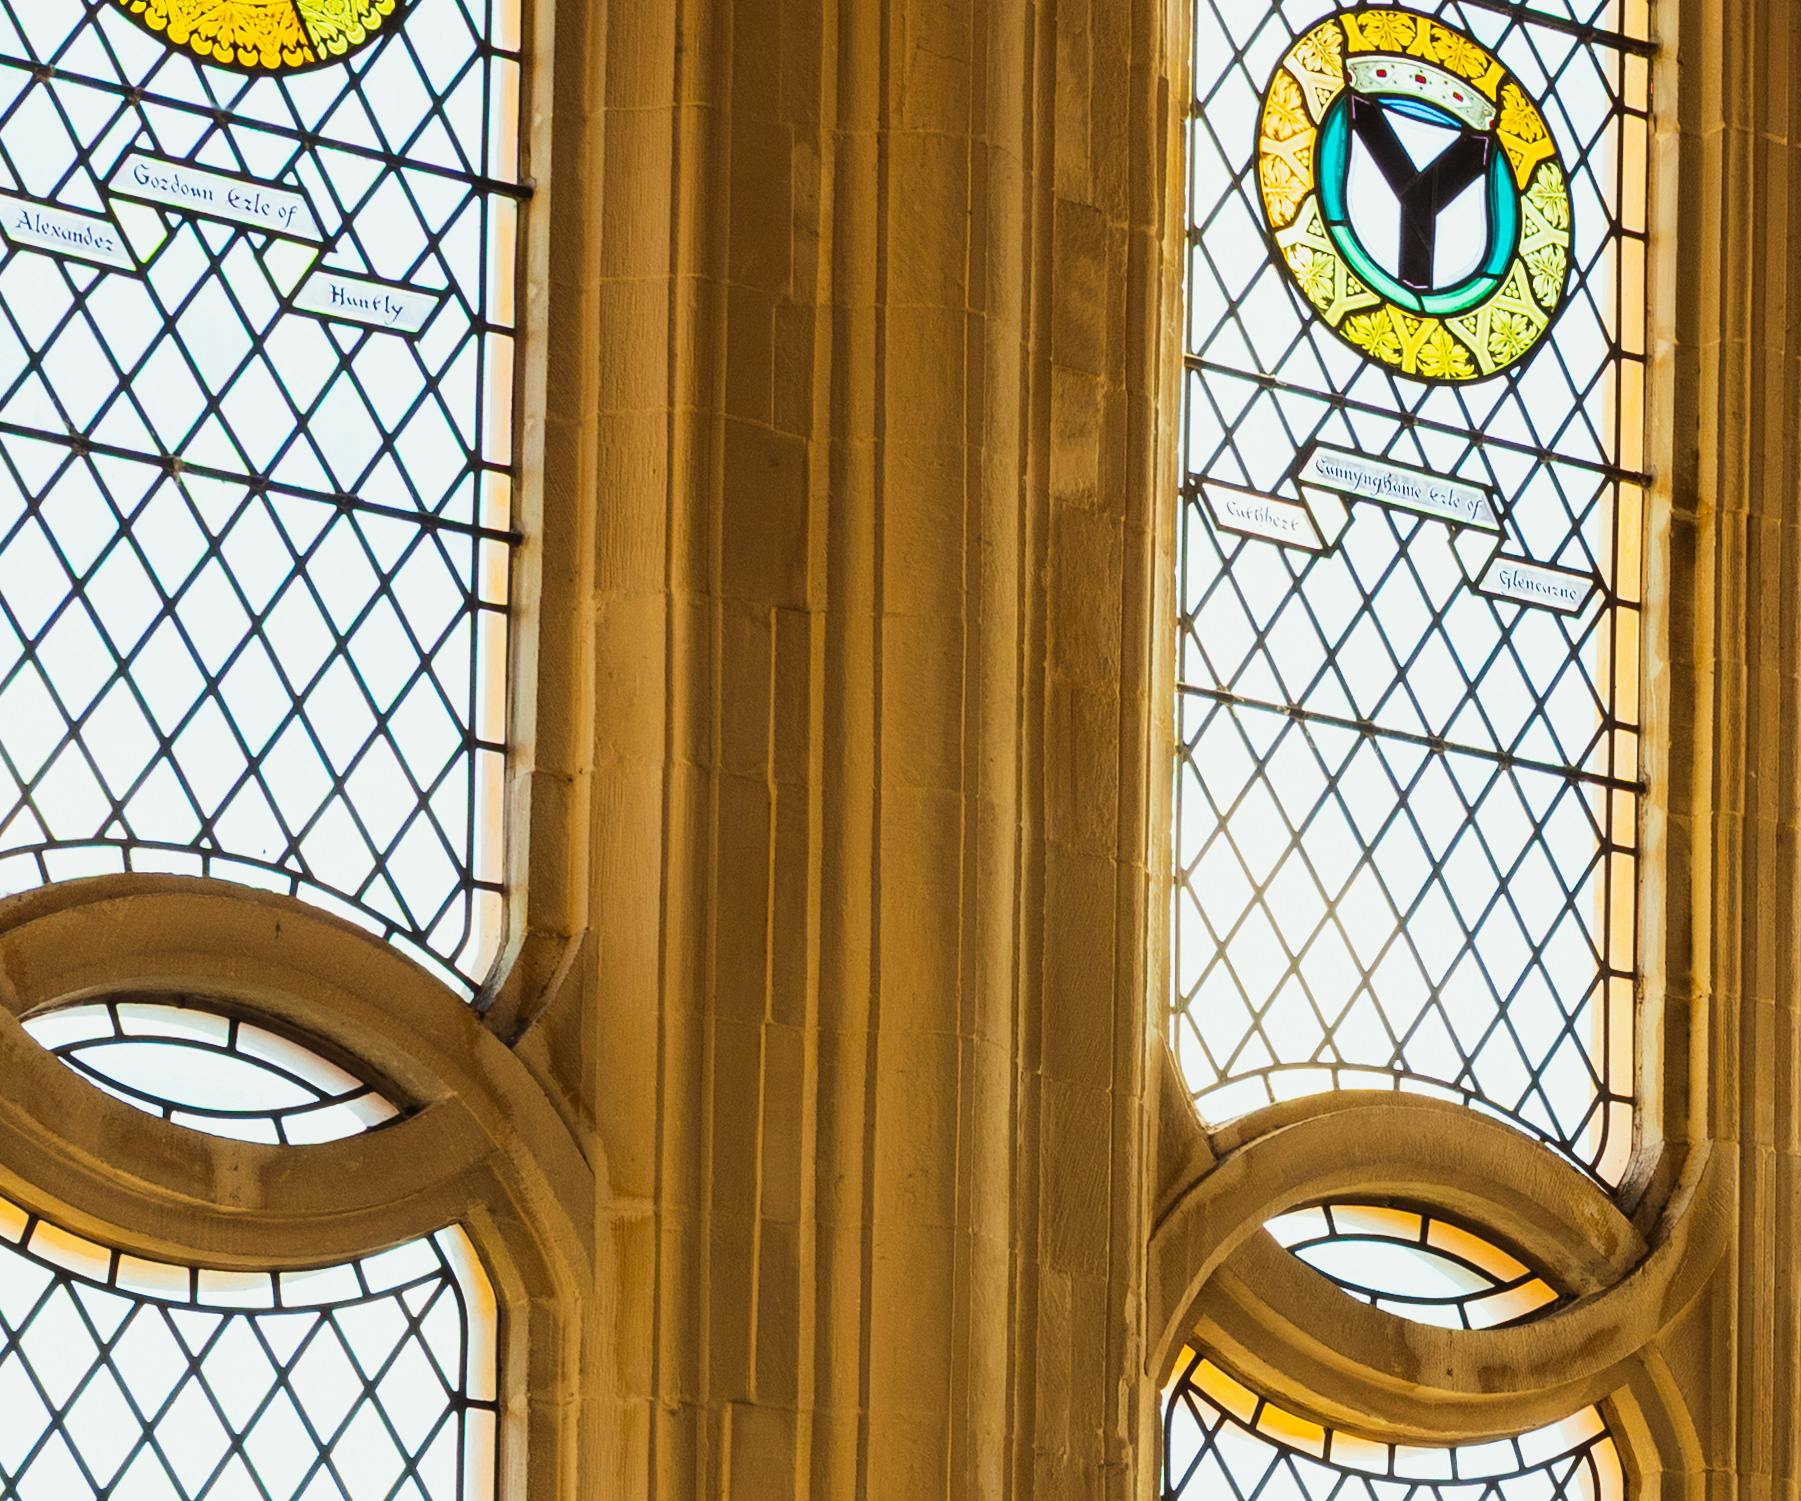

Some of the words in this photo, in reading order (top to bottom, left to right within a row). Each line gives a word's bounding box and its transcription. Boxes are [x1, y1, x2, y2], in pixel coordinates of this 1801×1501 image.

[278, 203, 298, 228] of
[329, 284, 404, 325] Huntly
[1466, 498, 1482, 520] of
